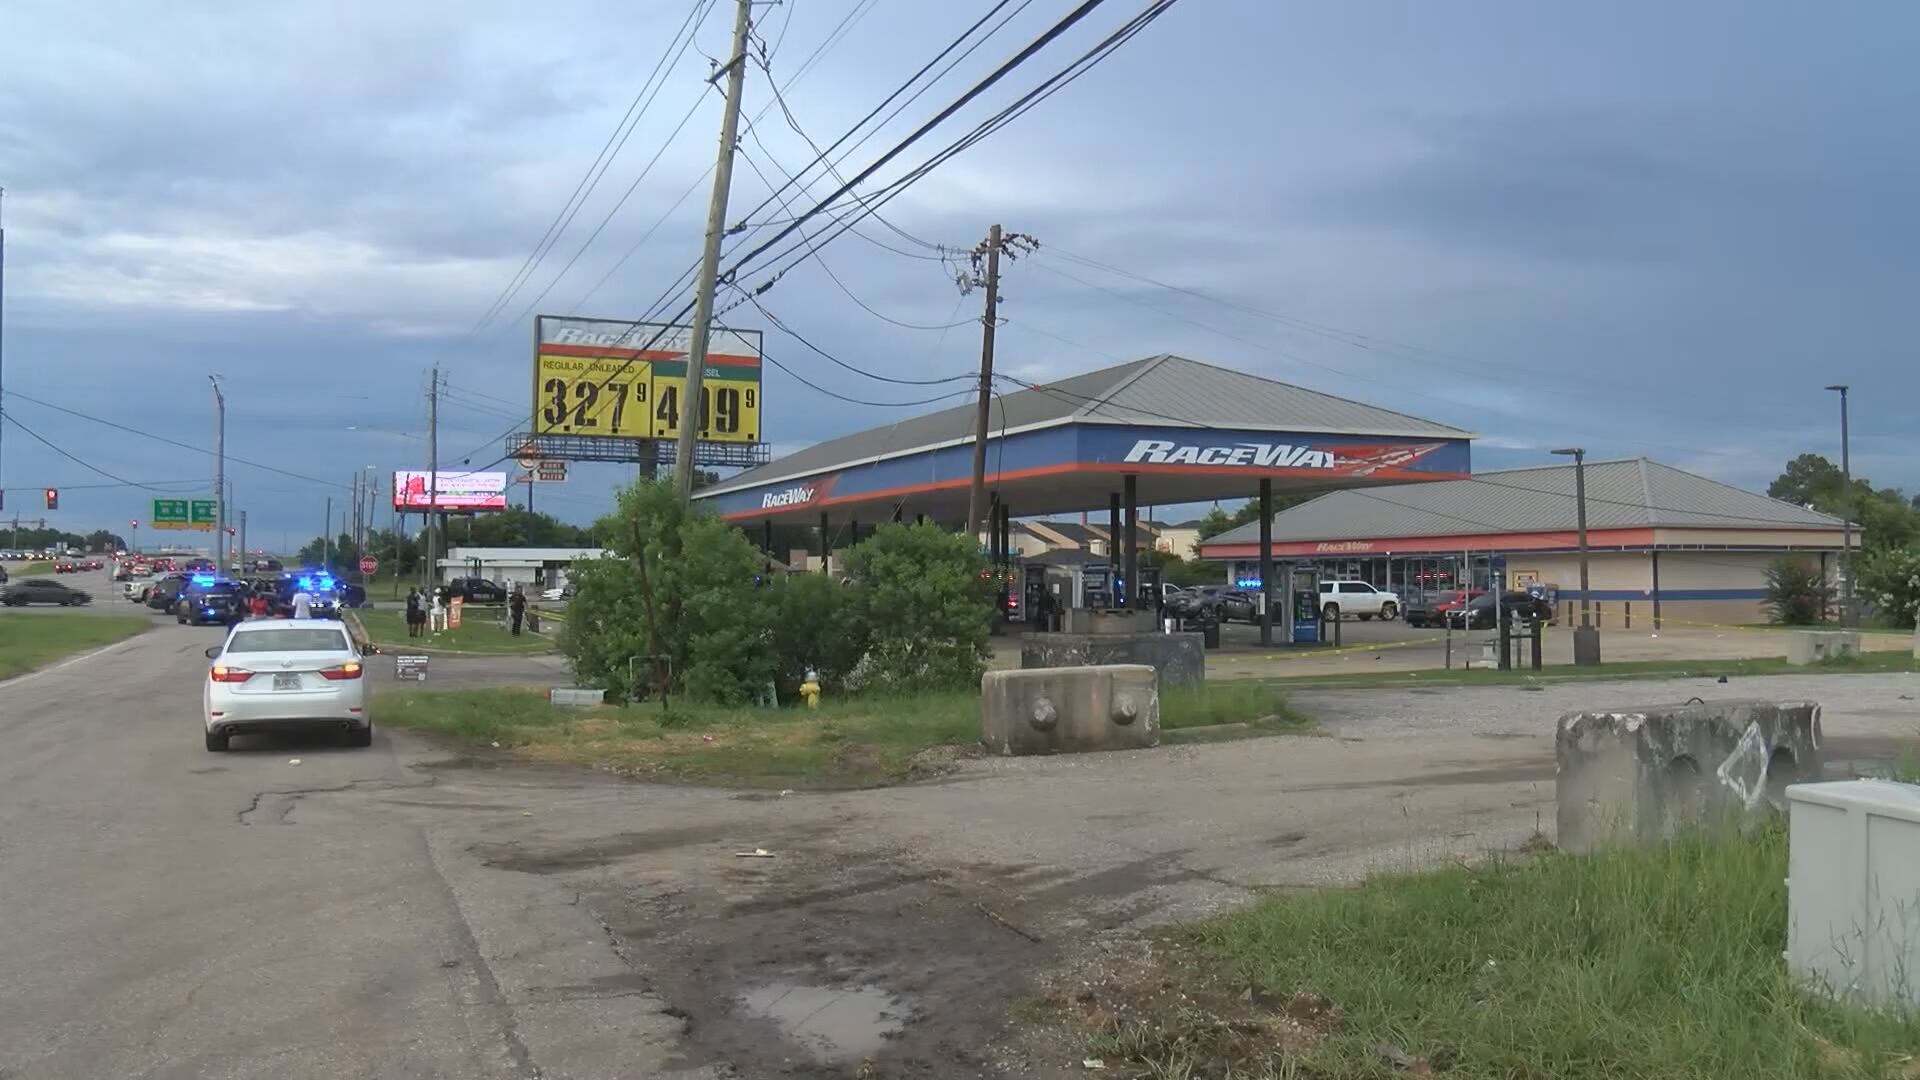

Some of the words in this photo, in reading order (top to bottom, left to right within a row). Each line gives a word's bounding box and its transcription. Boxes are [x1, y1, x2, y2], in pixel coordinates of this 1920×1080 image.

[543, 360, 584, 371] REGULAR
[589, 362, 635, 374] UNLEADED
[762, 487, 815, 509] RACEWAY
[361, 561, 377, 569] STOP
